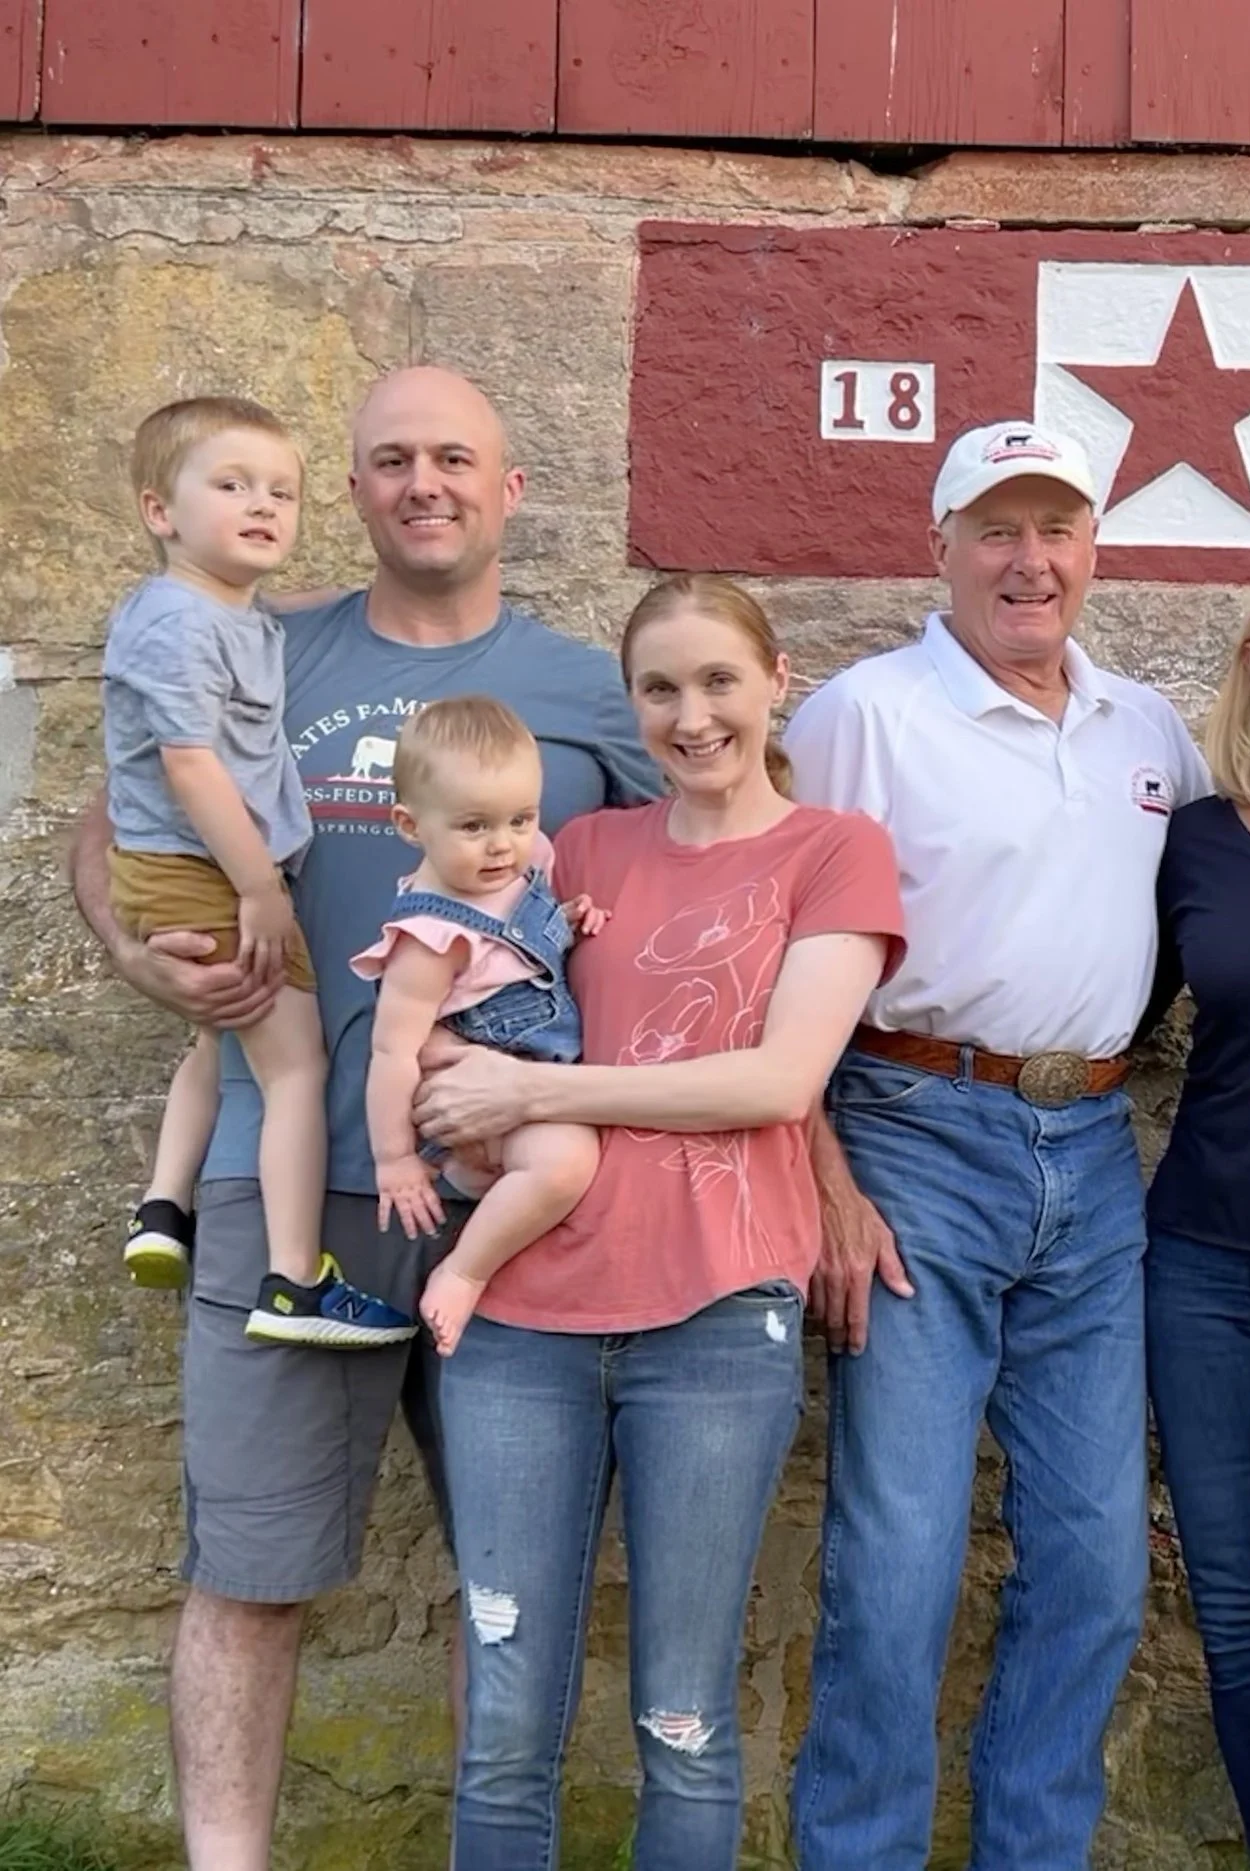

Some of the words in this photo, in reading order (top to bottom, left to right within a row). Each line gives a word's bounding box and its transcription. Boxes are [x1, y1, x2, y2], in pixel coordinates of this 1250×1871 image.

[833, 371, 922, 430] 18
[290, 709, 351, 760] ATES
[356, 697, 428, 721] FAM
[303, 787, 374, 803] SS-FED
